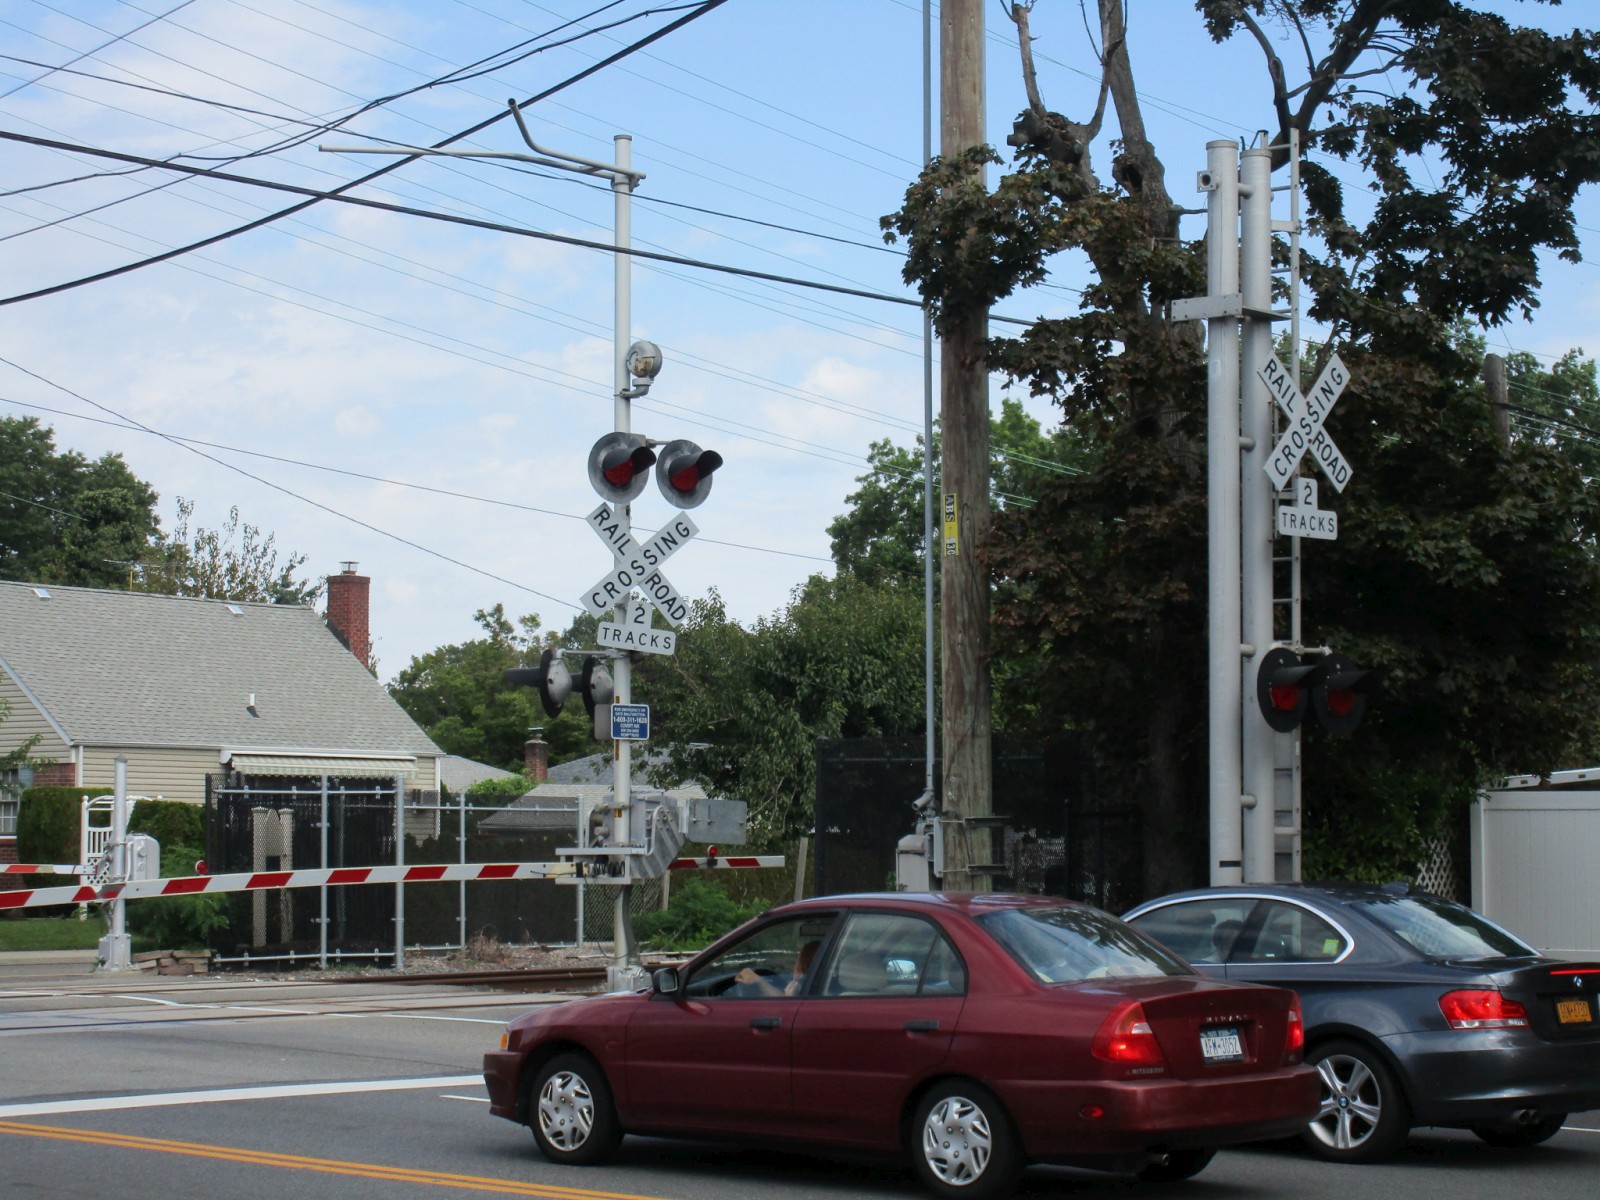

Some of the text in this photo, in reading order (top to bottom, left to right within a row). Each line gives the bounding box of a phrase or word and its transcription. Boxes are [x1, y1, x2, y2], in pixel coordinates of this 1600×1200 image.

[1263, 358, 1296, 413] RAIL
[1274, 367, 1343, 477] CROSSING
[1312, 431, 1348, 485] ROAD
[1303, 485, 1313, 505] 2
[593, 508, 631, 556] RAIL
[1282, 512, 1335, 533] TRACKS
[592, 522, 690, 608] CROSSING
[634, 606, 646, 624] 2
[645, 573, 686, 620] ROAD
[602, 627, 671, 649] TRACKS
